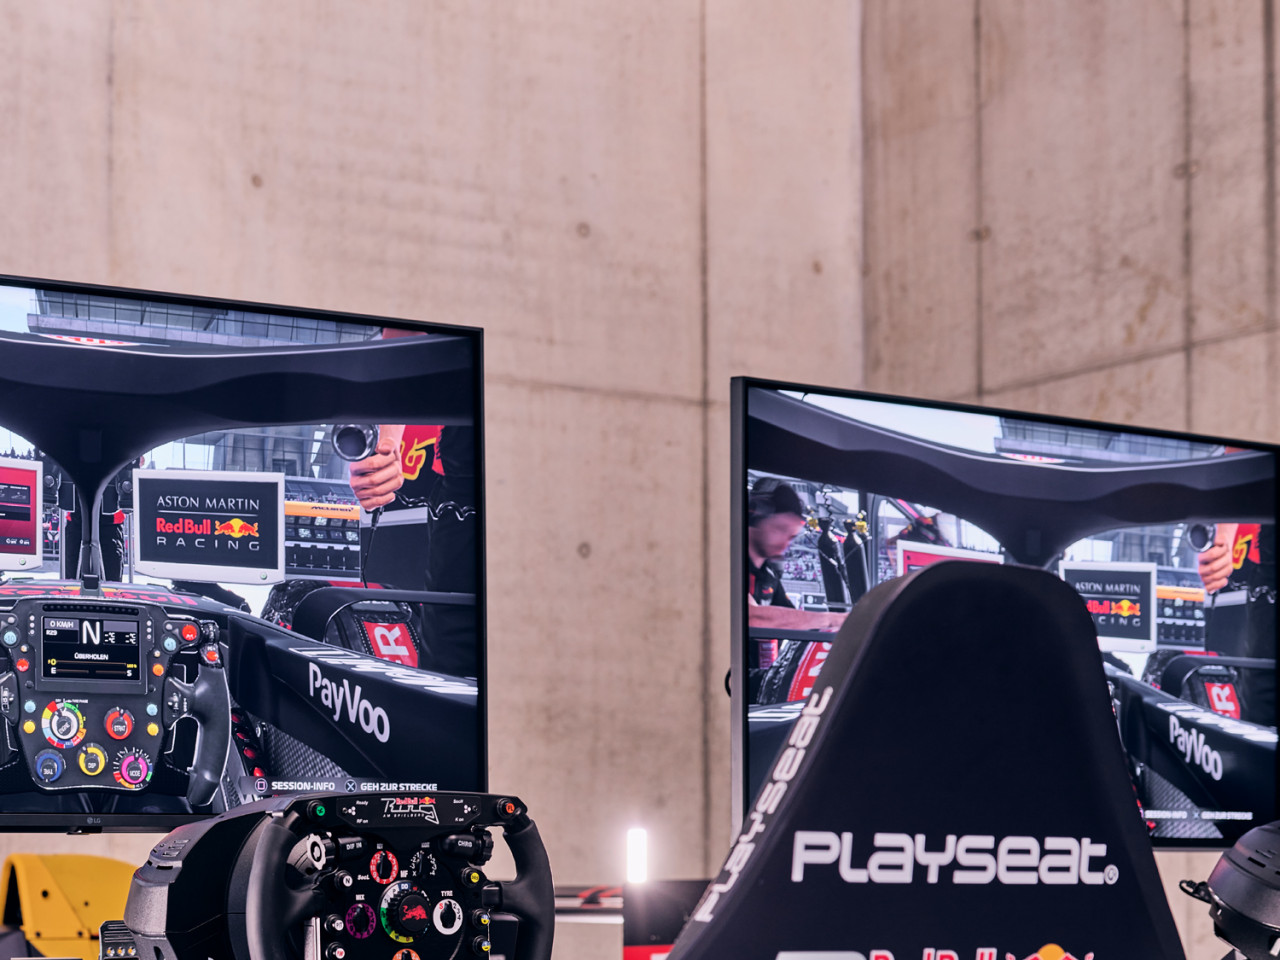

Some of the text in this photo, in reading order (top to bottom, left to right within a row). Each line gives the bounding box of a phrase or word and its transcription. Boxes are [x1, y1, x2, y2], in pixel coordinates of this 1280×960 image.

[156, 495, 260, 511] ASTON MARTIN
[156, 517, 211, 535] Red Bull
[156, 536, 260, 551] RACING
[1075, 581, 1141, 594] ASTON MARTIN
[1091, 615, 1141, 627] CING
[82, 620, 100, 645] N
[308, 661, 391, 743] PayVoo
[1169, 714, 1223, 781] PayVoo
[271, 781, 336, 791] SESSION-INFO
[360, 783, 438, 792] GEH ZUR STRECKE
